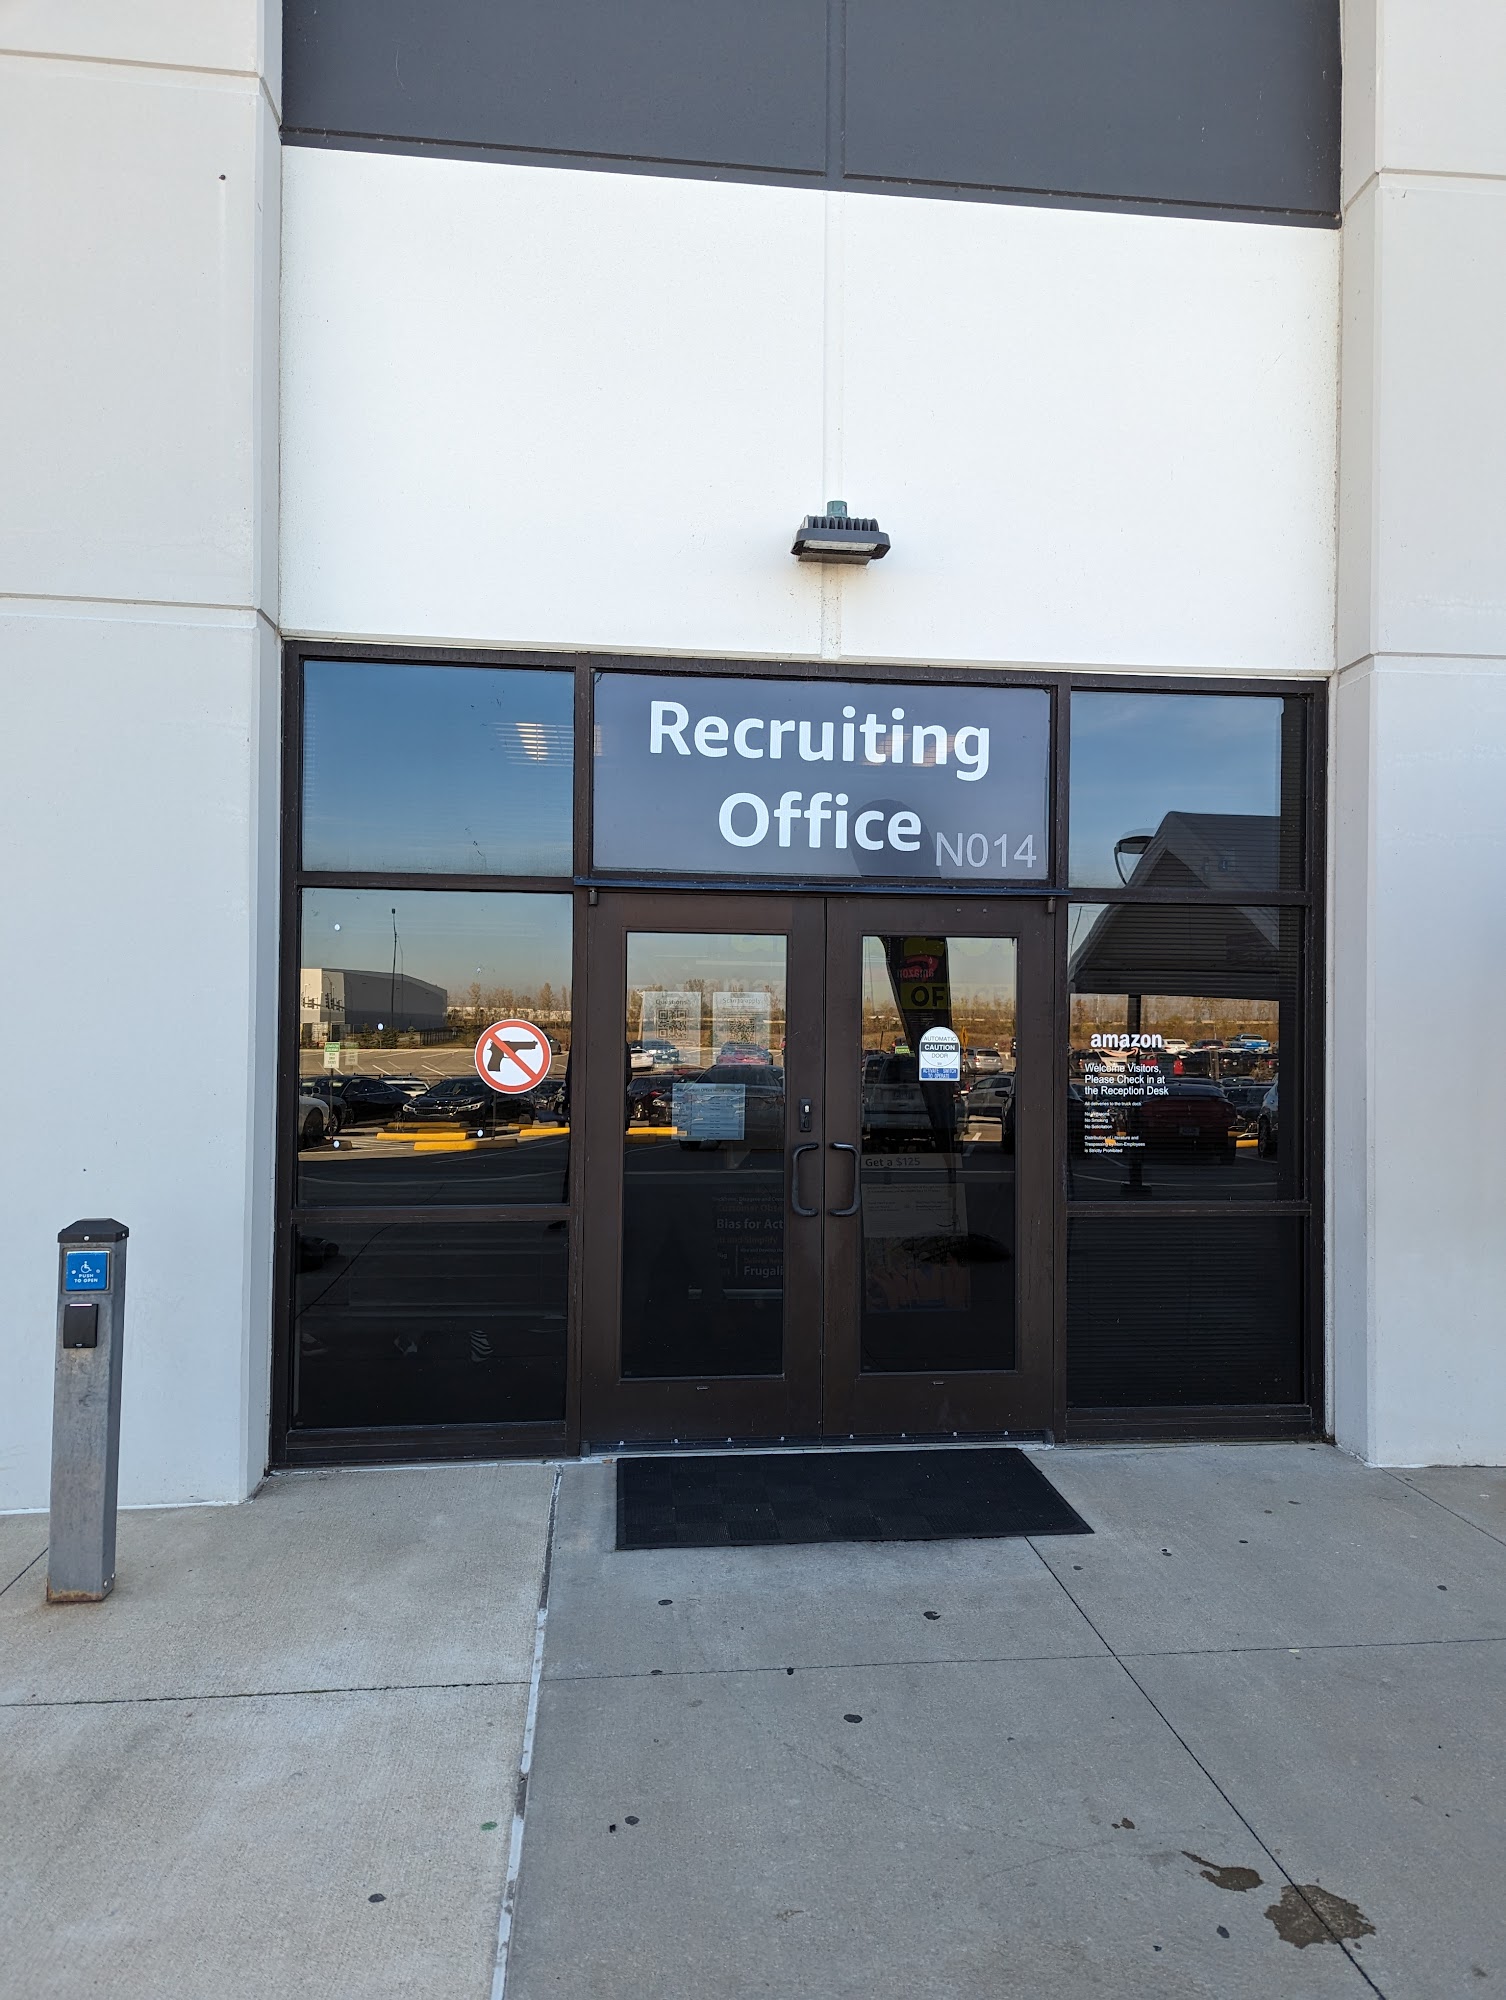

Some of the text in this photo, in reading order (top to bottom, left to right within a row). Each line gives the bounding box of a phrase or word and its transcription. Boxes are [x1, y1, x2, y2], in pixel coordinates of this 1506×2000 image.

[649, 700, 990, 782] Recruiting
[718, 791, 922, 852] Office
[935, 832, 1037, 869] N014
[1090, 1033, 1162, 1048] amazon
[1084, 1063, 1162, 1074] Welcome Visitors,
[1084, 1074, 1166, 1084] Please Check in at
[1084, 1086, 1169, 1097] the Reception Desk
[865, 1157, 920, 1167] Get a $125
[716, 1218, 784, 1229] Bias for Act
[743, 1265, 784, 1278] Frugali
